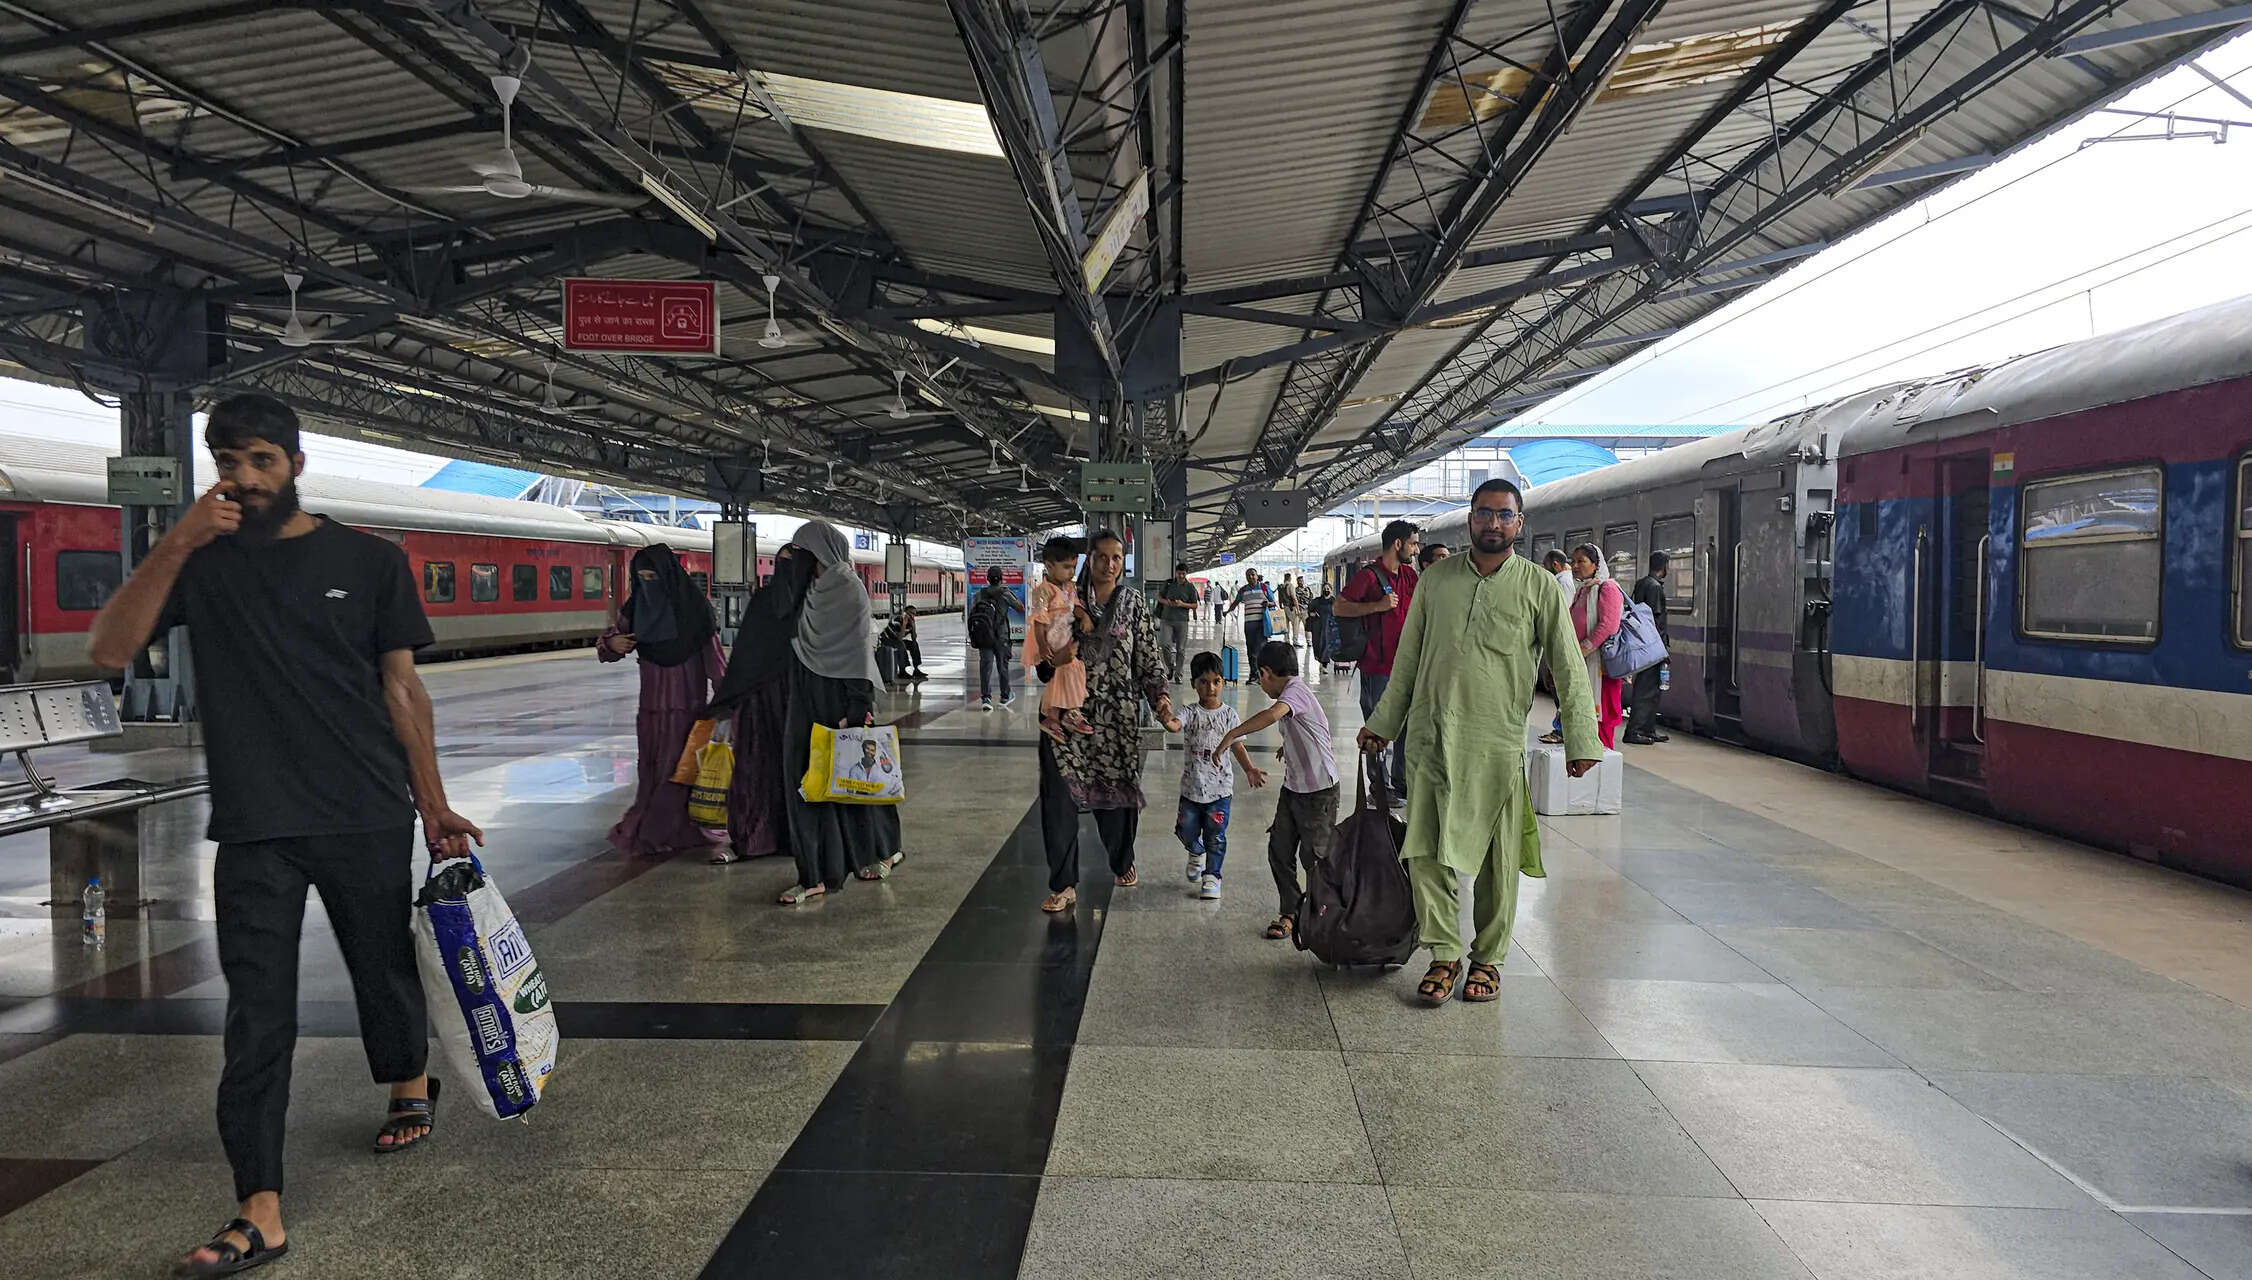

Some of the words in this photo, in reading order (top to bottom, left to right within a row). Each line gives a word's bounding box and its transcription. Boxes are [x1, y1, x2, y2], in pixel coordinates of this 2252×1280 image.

[578, 316, 592, 327] पुल
[594, 314, 602, 324] से
[603, 315, 620, 326] जाने
[622, 317, 633, 326] का
[635, 318, 655, 327] रास्ता
[578, 333, 600, 341] FOOT
[601, 334, 623, 342] OVER
[625, 334, 655, 343] BRIDGE
[859, 536, 868, 548] 3
[459, 959, 476, 985] (ATTA)
[477, 1009, 502, 1050] AMARS
[498, 1070, 515, 1095] (ATTA)
